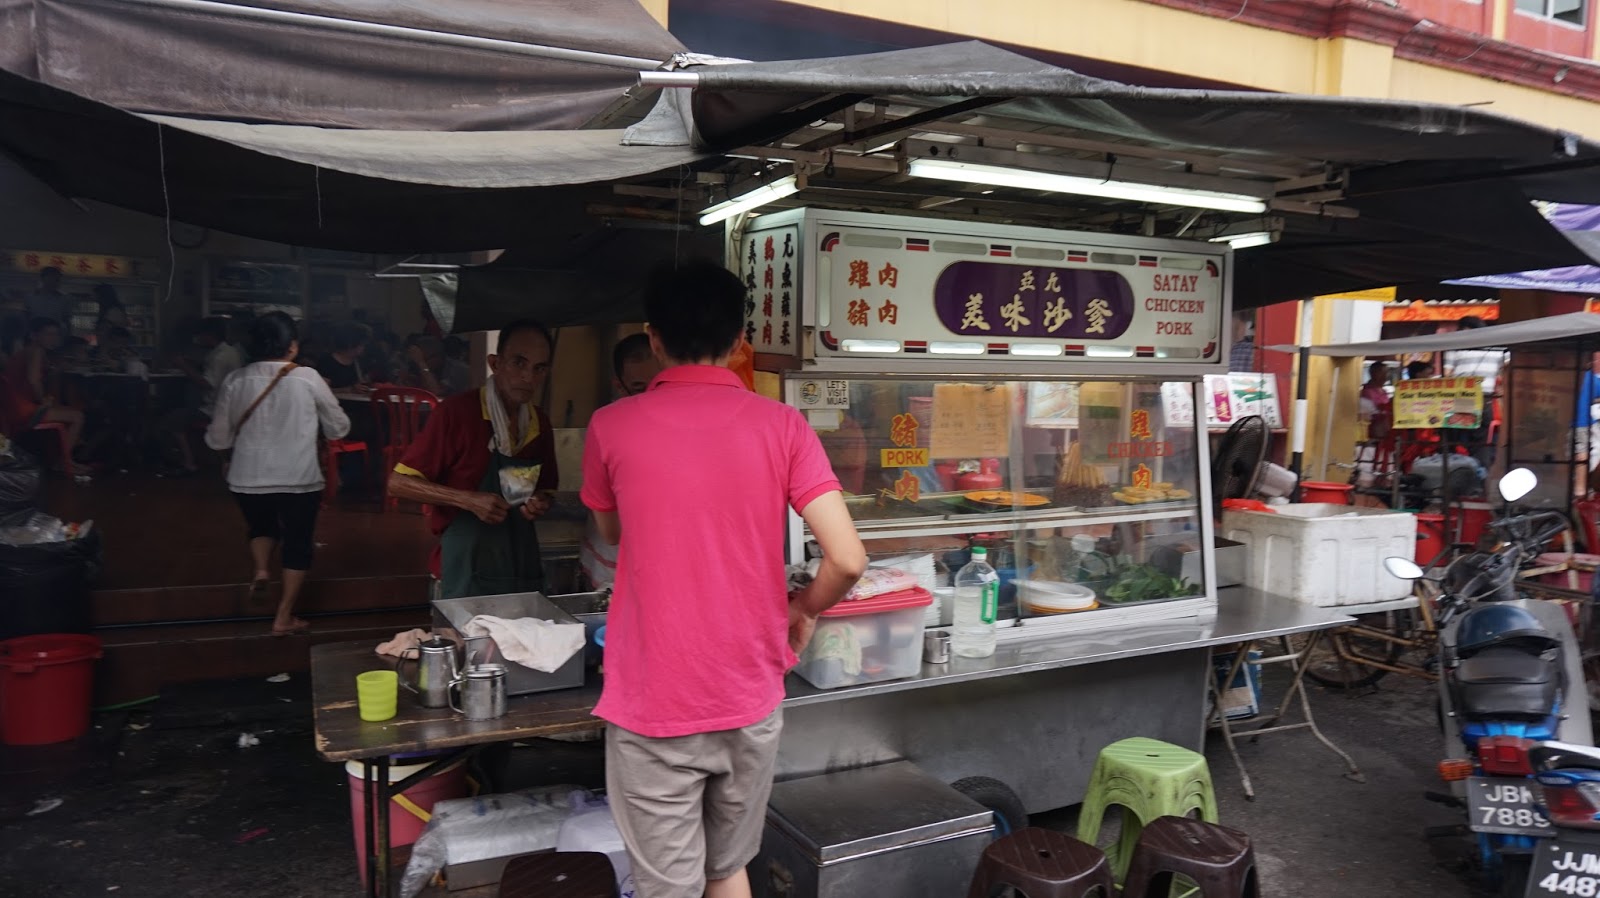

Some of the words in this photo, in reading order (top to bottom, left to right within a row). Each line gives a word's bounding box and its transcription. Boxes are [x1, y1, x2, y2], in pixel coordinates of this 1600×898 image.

[1153, 274, 1199, 292] SATAY
[960, 292, 1114, 334] 美味沙爹
[1145, 298, 1205, 313] CHICKEN
[1156, 321, 1193, 335] PORK
[826, 380, 847, 389] LET'S
[827, 389, 847, 397] VISIT
[826, 397, 848, 405] MUAR
[887, 450, 924, 465] PORK
[1539, 872, 1600, 898] 448
